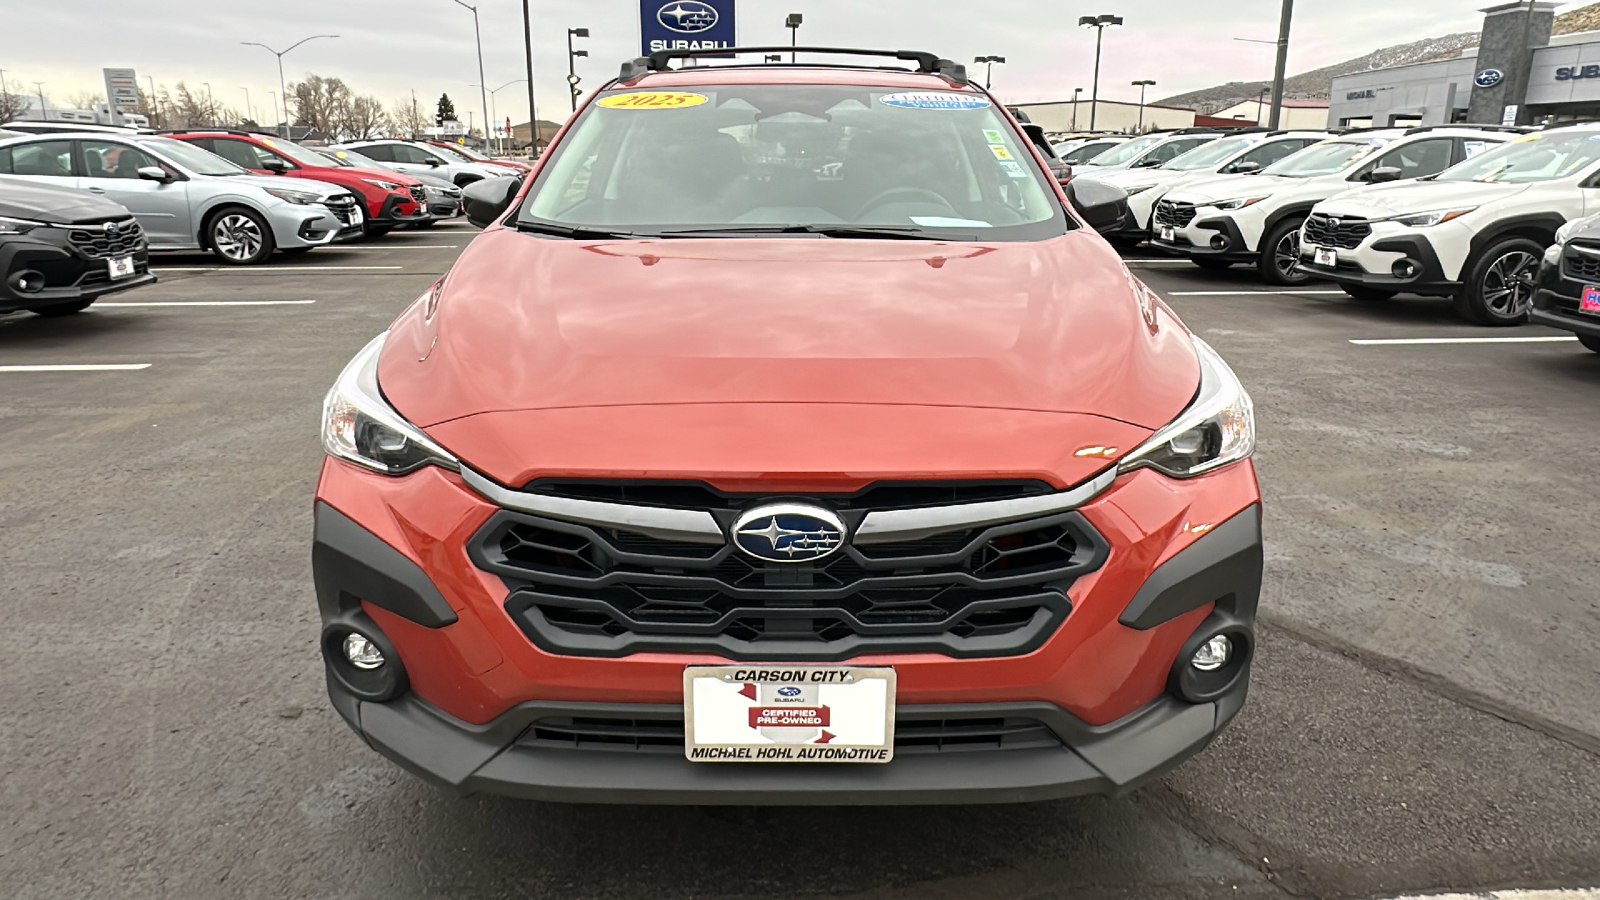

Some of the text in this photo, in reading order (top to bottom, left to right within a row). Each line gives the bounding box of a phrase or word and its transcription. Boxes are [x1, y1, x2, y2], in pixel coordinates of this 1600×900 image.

[650, 40, 727, 52] SUBARU
[613, 94, 694, 106] 2025
[734, 670, 849, 682] CARSON CITY
[762, 709, 817, 717] CERTIFIED
[757, 717, 822, 725] PRE-OWNED
[691, 747, 888, 760] MICHAEL HOHL AUTOMOTIVE
